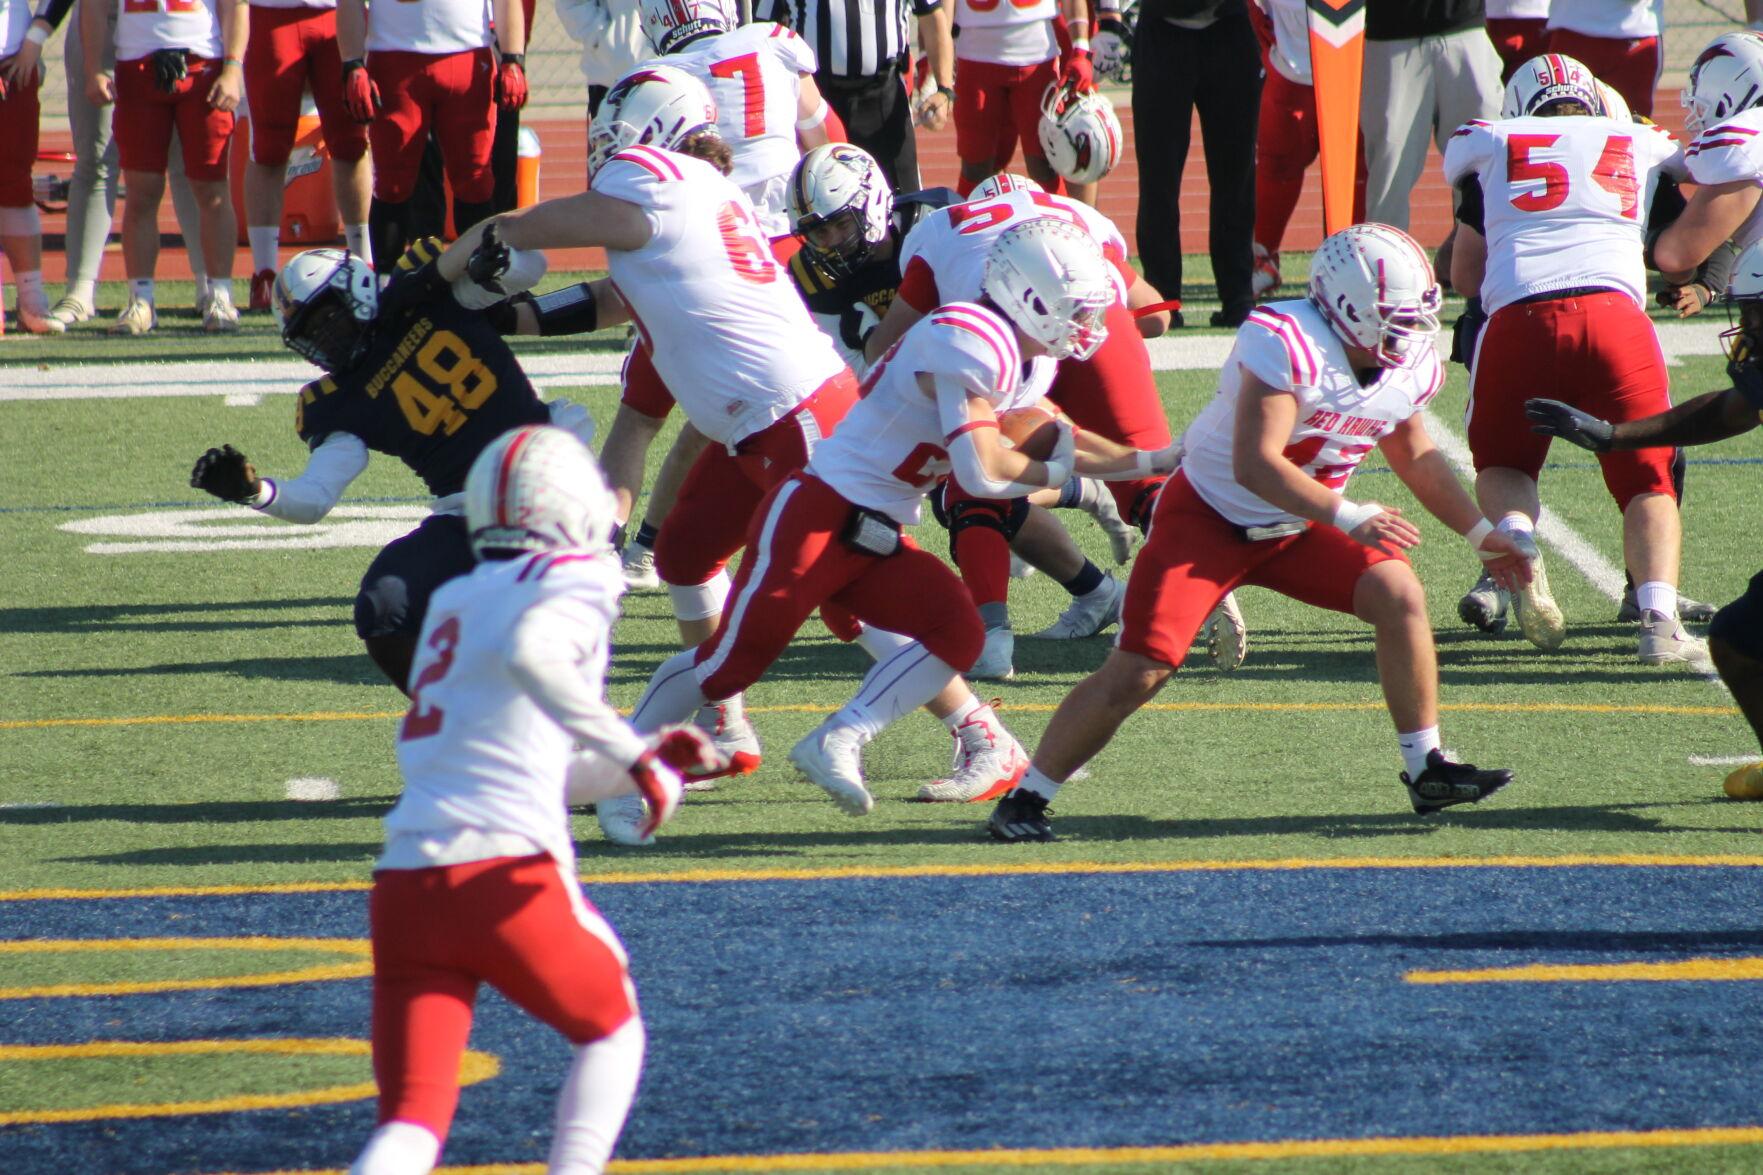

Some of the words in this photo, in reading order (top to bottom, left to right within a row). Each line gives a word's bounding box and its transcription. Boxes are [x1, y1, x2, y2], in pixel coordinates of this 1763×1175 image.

[672, 20, 702, 38] schutt
[1507, 133, 1641, 221] 54
[365, 317, 433, 399] BUCCANEERS
[391, 329, 498, 436] 48
[1303, 408, 1342, 432] RED
[400, 615, 460, 741] 2
